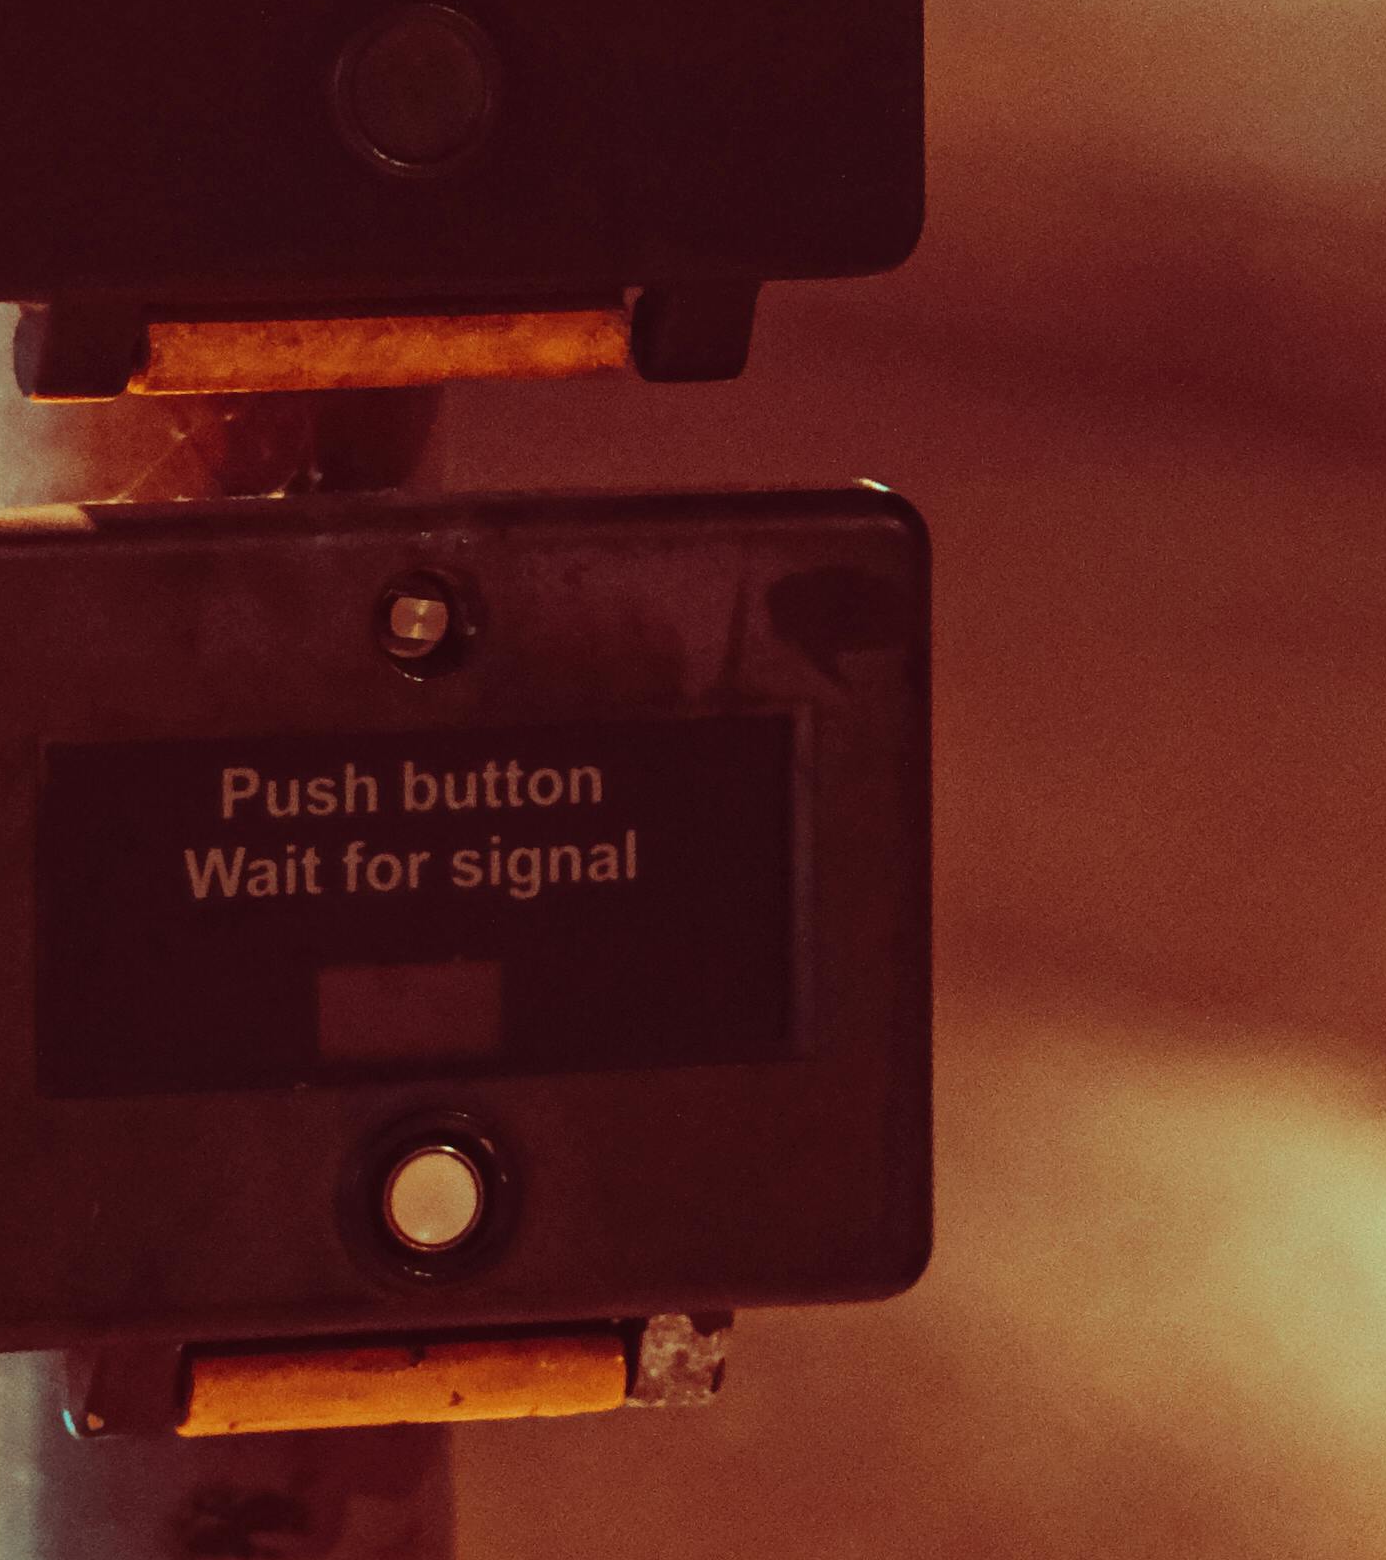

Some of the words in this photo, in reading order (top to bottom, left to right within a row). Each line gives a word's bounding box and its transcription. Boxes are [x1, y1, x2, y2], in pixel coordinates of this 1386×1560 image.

[219, 762, 379, 819] Push
[401, 759, 604, 812] button
[184, 843, 323, 899] Wait
[342, 839, 431, 893] for
[451, 829, 639, 899] signal
